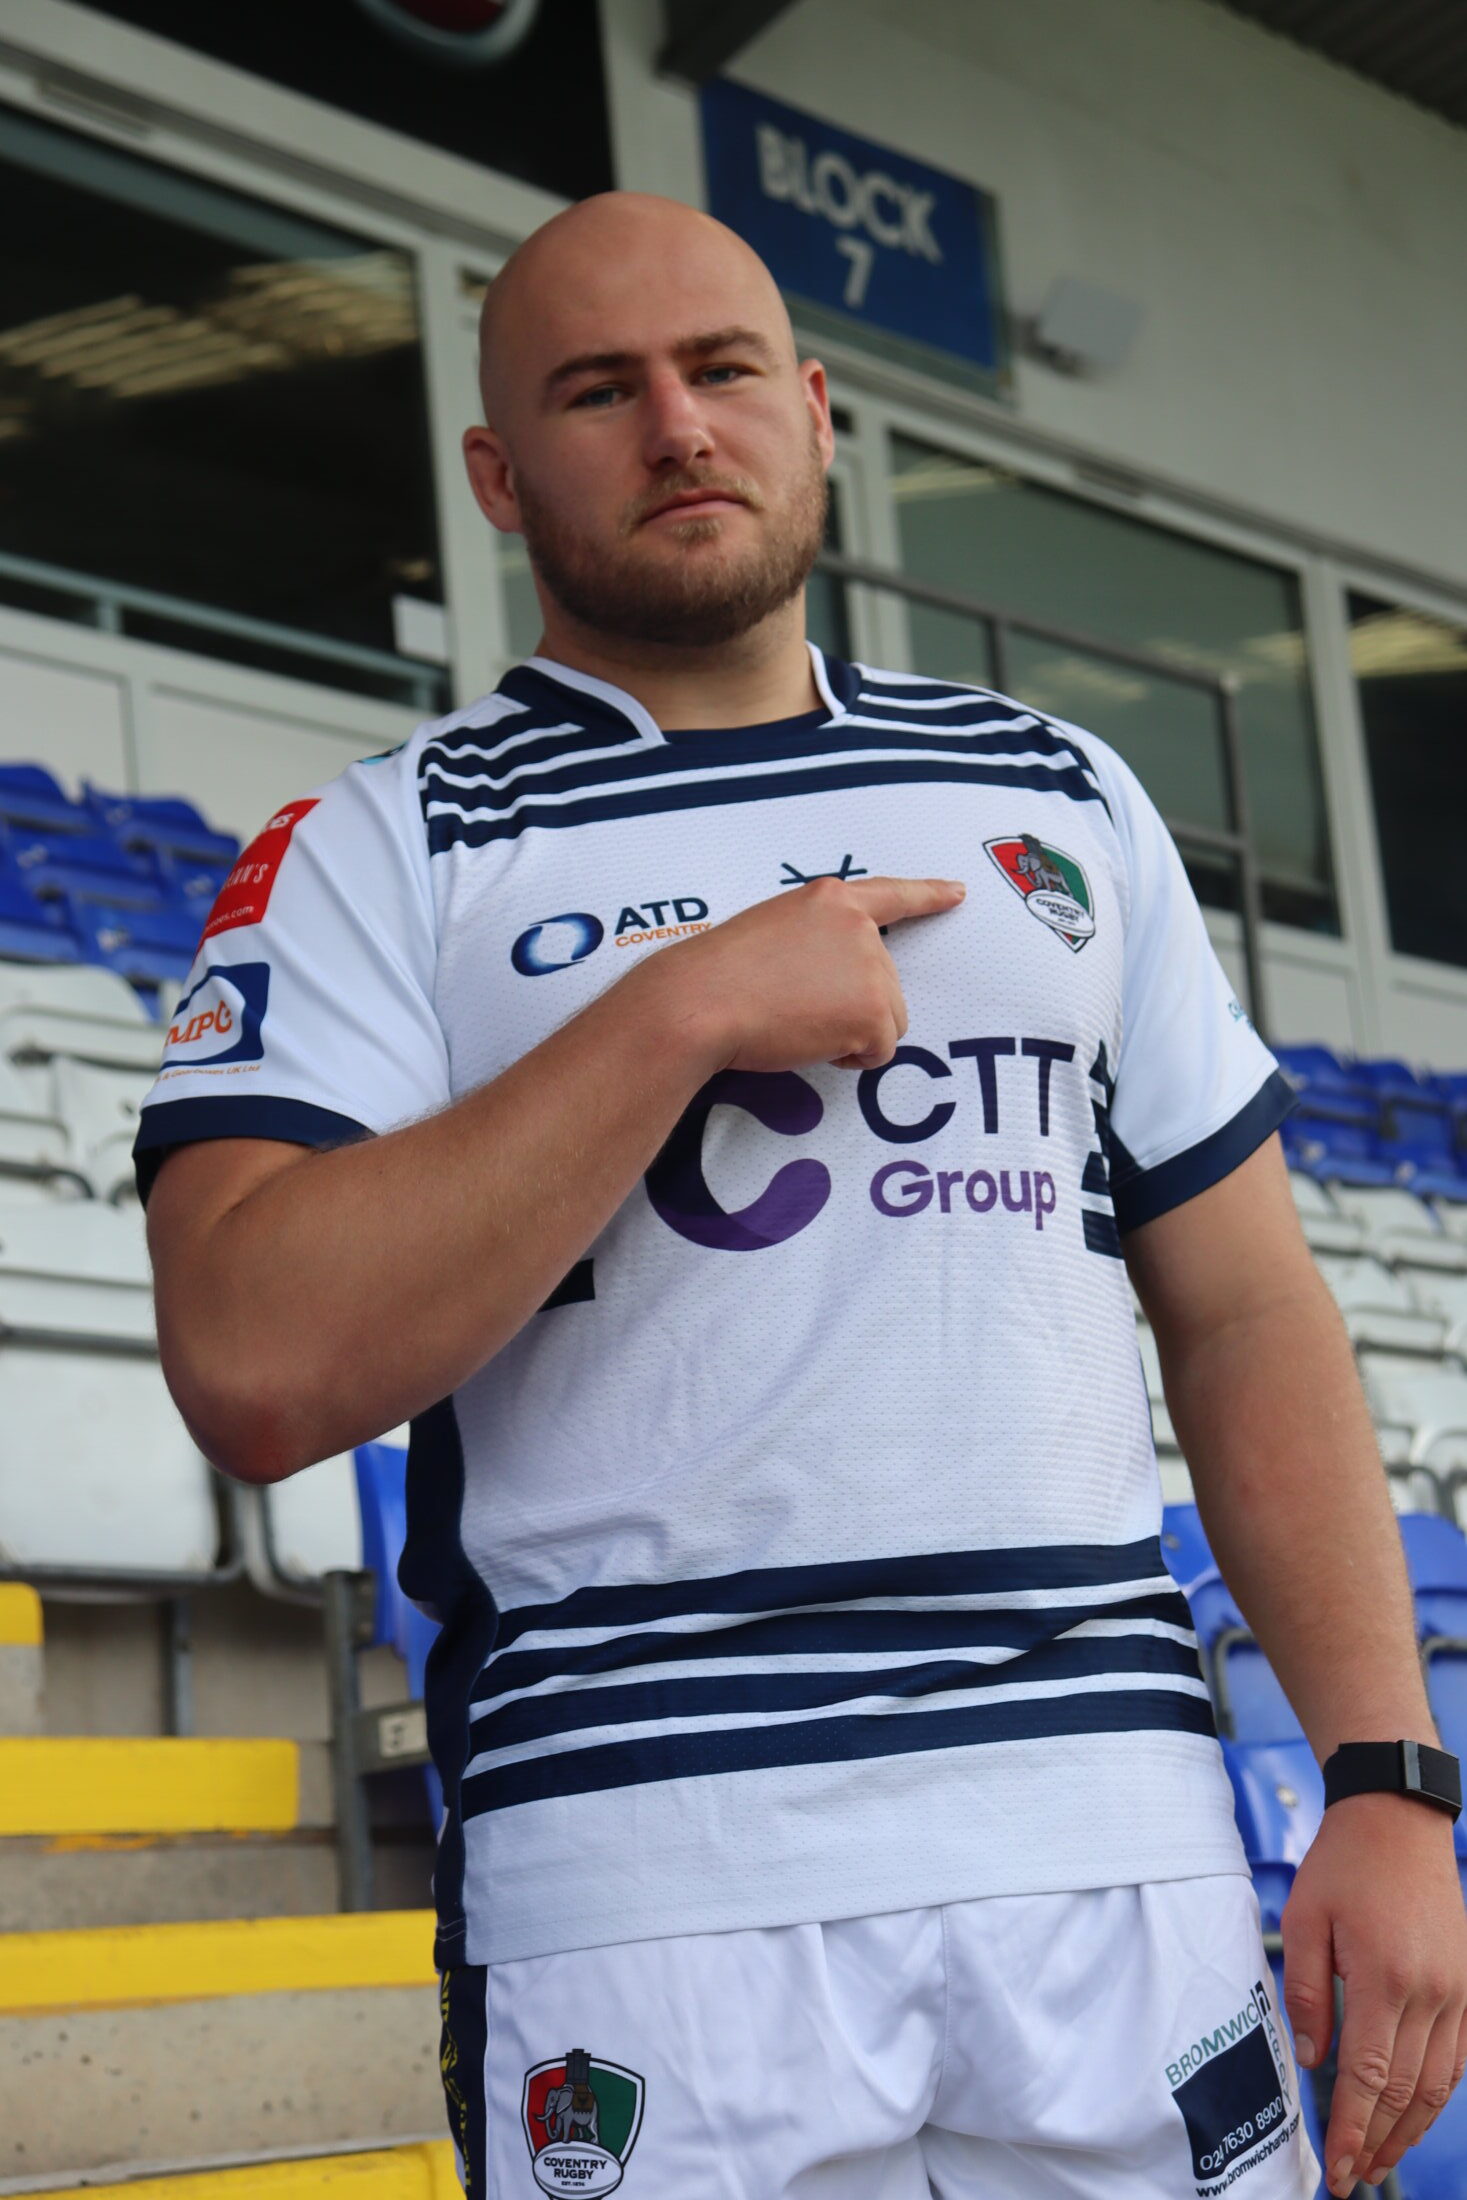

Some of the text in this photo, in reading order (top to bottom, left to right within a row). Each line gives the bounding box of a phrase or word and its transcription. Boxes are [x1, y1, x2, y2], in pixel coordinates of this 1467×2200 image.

[757, 123, 943, 266] BLOCK
[835, 236, 874, 309] 7
[614, 897, 709, 935] ATD
[615, 922, 712, 947] COVENTRY
[857, 1036, 1075, 1144] CTT
[869, 1160, 1057, 1231] Group
[1255, 2096, 1283, 2130] 8900
[543, 2157, 608, 2170] COVENTRY
[553, 2168, 594, 2180] RUGBY
